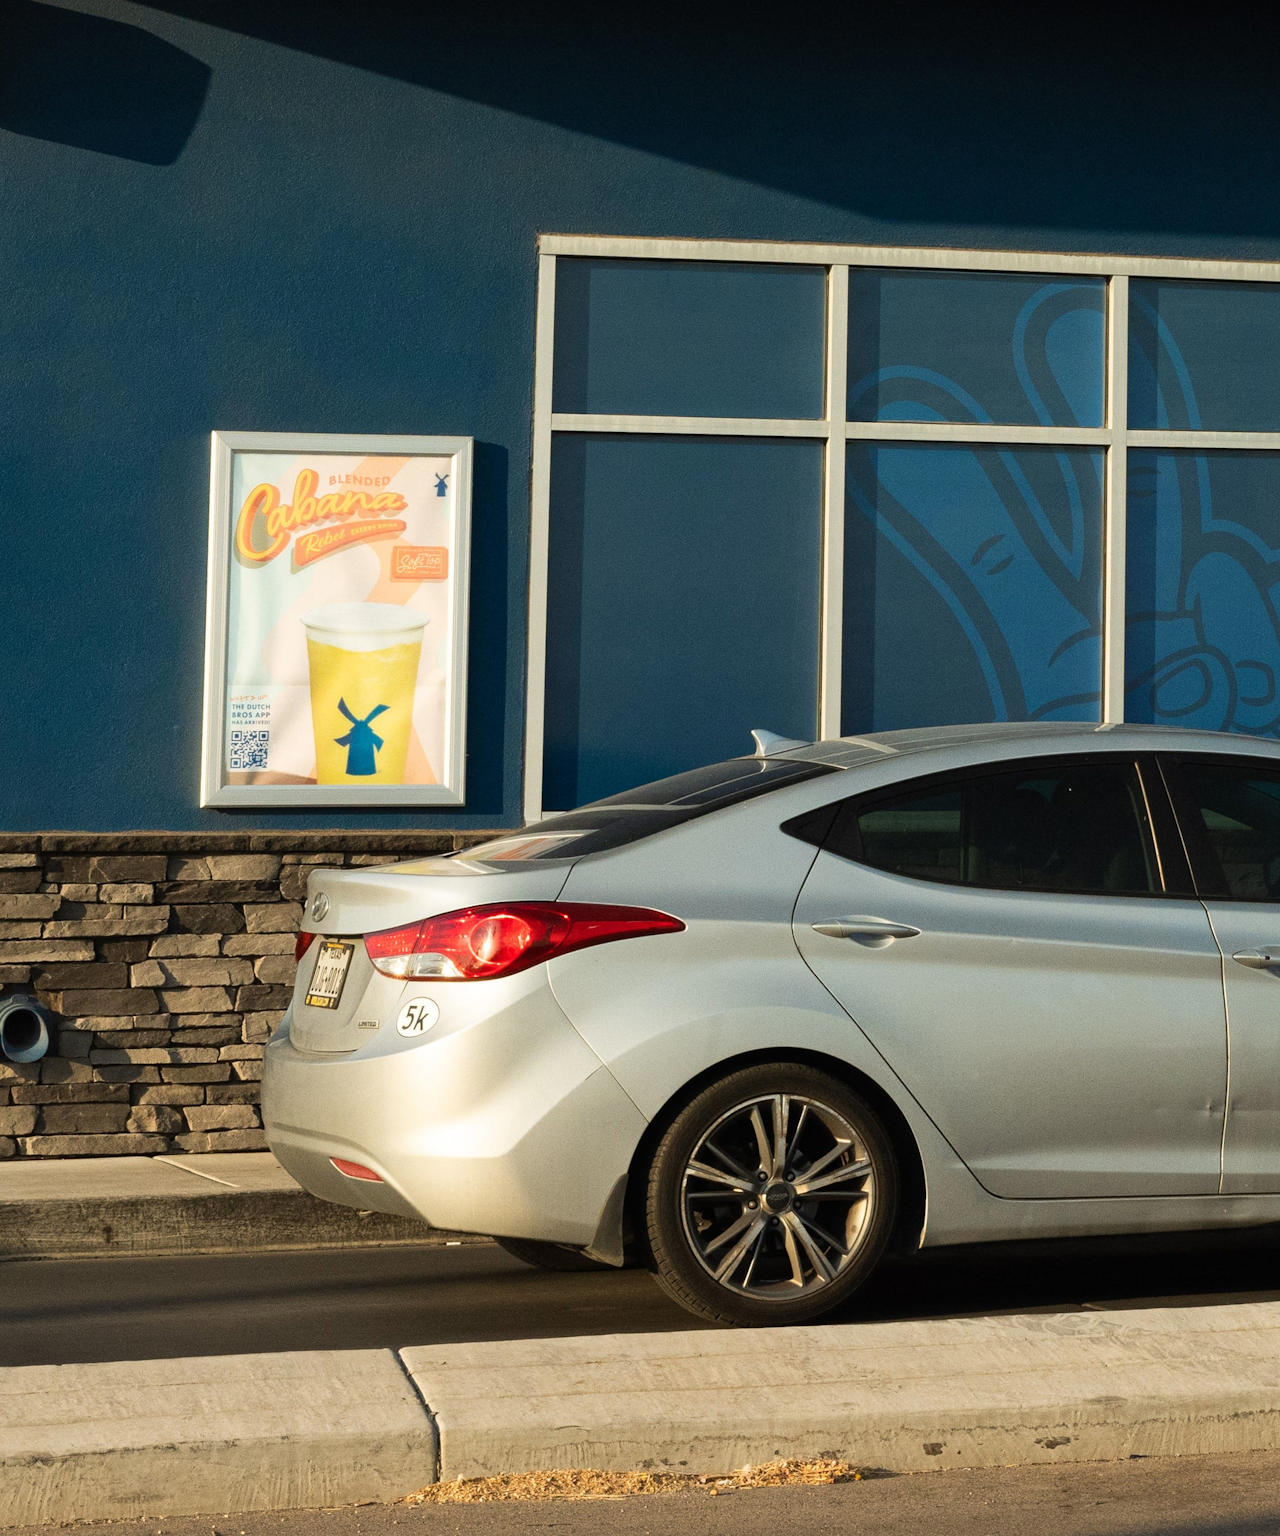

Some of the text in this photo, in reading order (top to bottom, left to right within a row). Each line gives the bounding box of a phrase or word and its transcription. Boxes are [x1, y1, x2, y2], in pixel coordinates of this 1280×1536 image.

[328, 474, 391, 487] BLENDED
[235, 467, 409, 564] Cabana
[300, 528, 346, 558] Rebel
